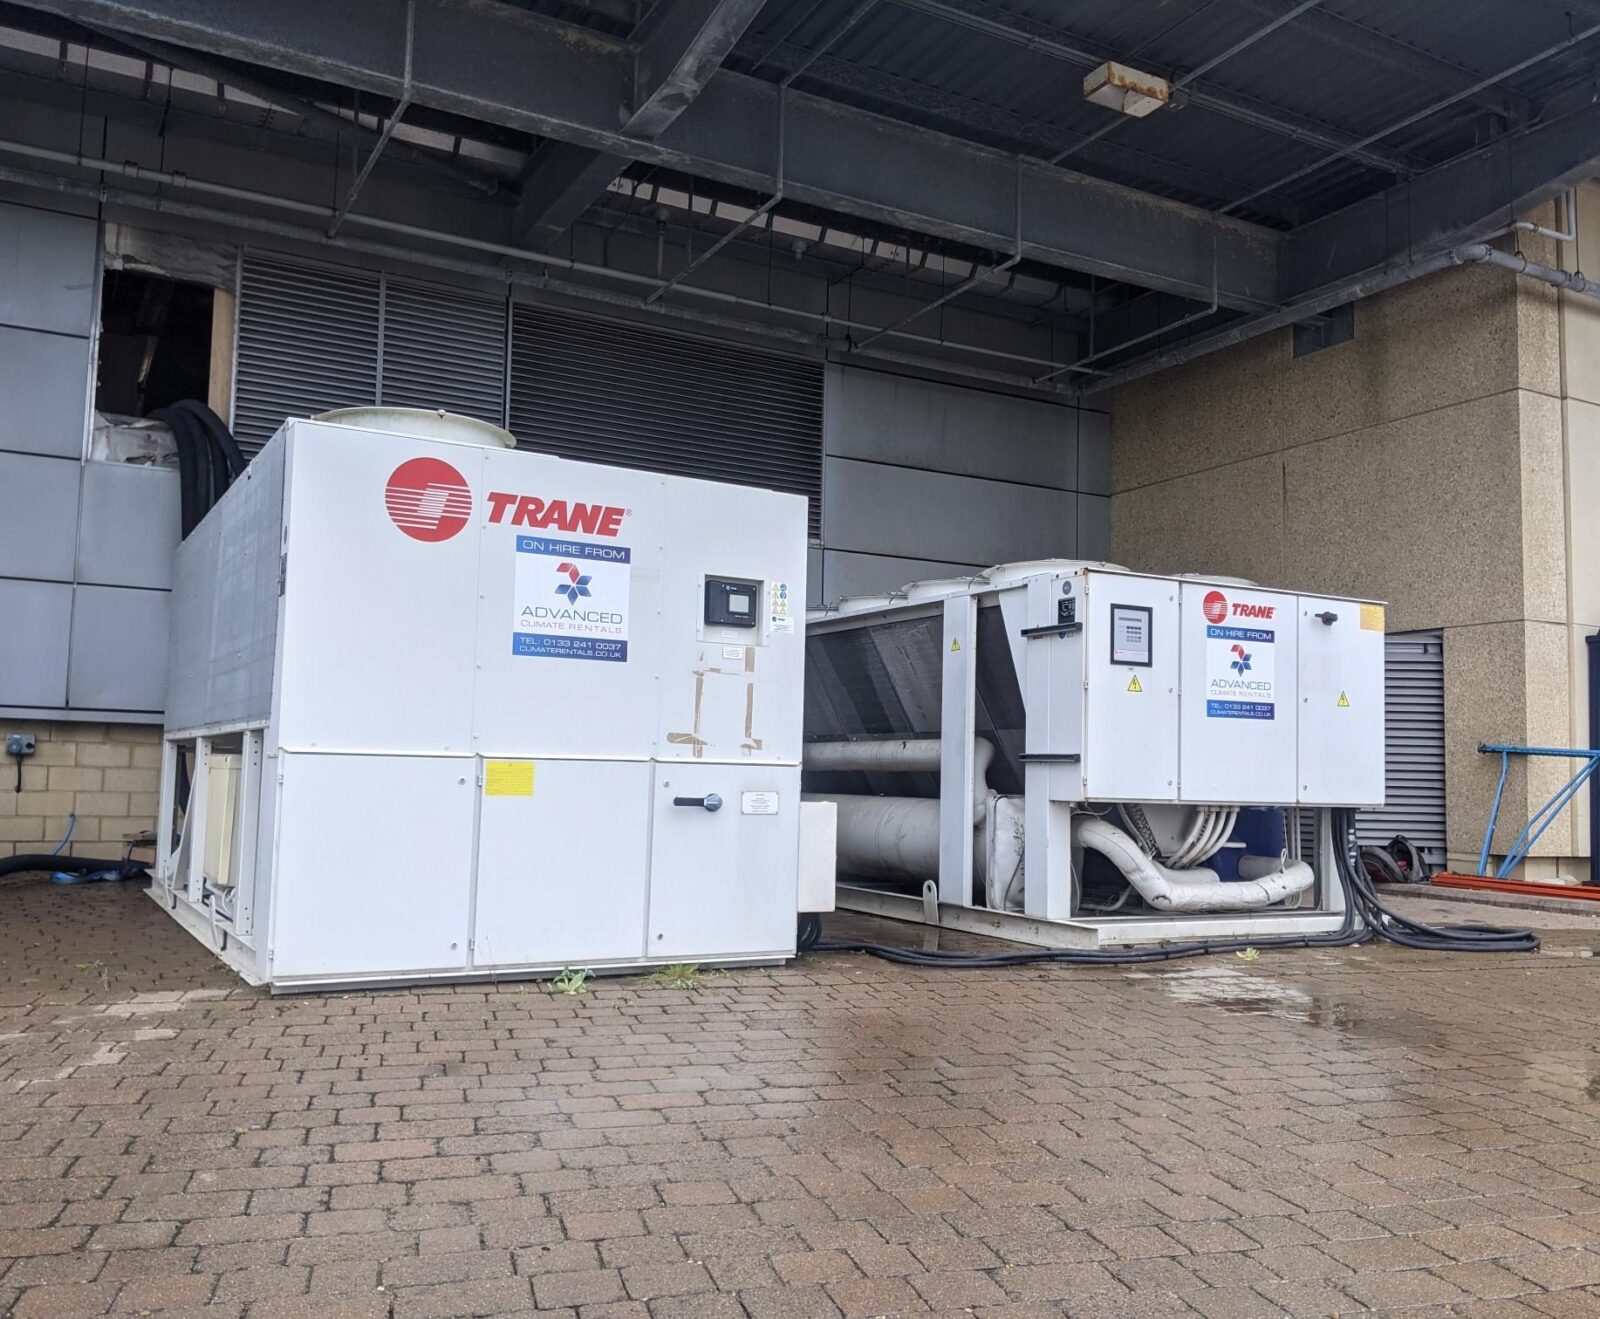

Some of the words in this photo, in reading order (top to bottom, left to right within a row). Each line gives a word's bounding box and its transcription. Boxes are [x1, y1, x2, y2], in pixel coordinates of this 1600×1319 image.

[487, 491, 625, 537] TRANE
[522, 539, 545, 551] ON
[549, 543, 581, 555] HIRE
[585, 547, 625, 560] FROM
[521, 605, 623, 624] ADVANCED
[1232, 603, 1274, 619] TRANE
[520, 619, 565, 630] CLIMATE
[568, 623, 622, 634] RENTALS
[1210, 628, 1224, 636] ON
[1226, 630, 1245, 638] HIRE
[1246, 631, 1272, 640] FROM
[520, 636, 540, 645] TEL:
[543, 638, 571, 648] 0133
[573, 640, 592, 649] 241
[595, 642, 622, 651] 0037
[519, 645, 622, 658] CLIMATERENTALS.CO.UK
[1211, 679, 1271, 690] ADVANCED
